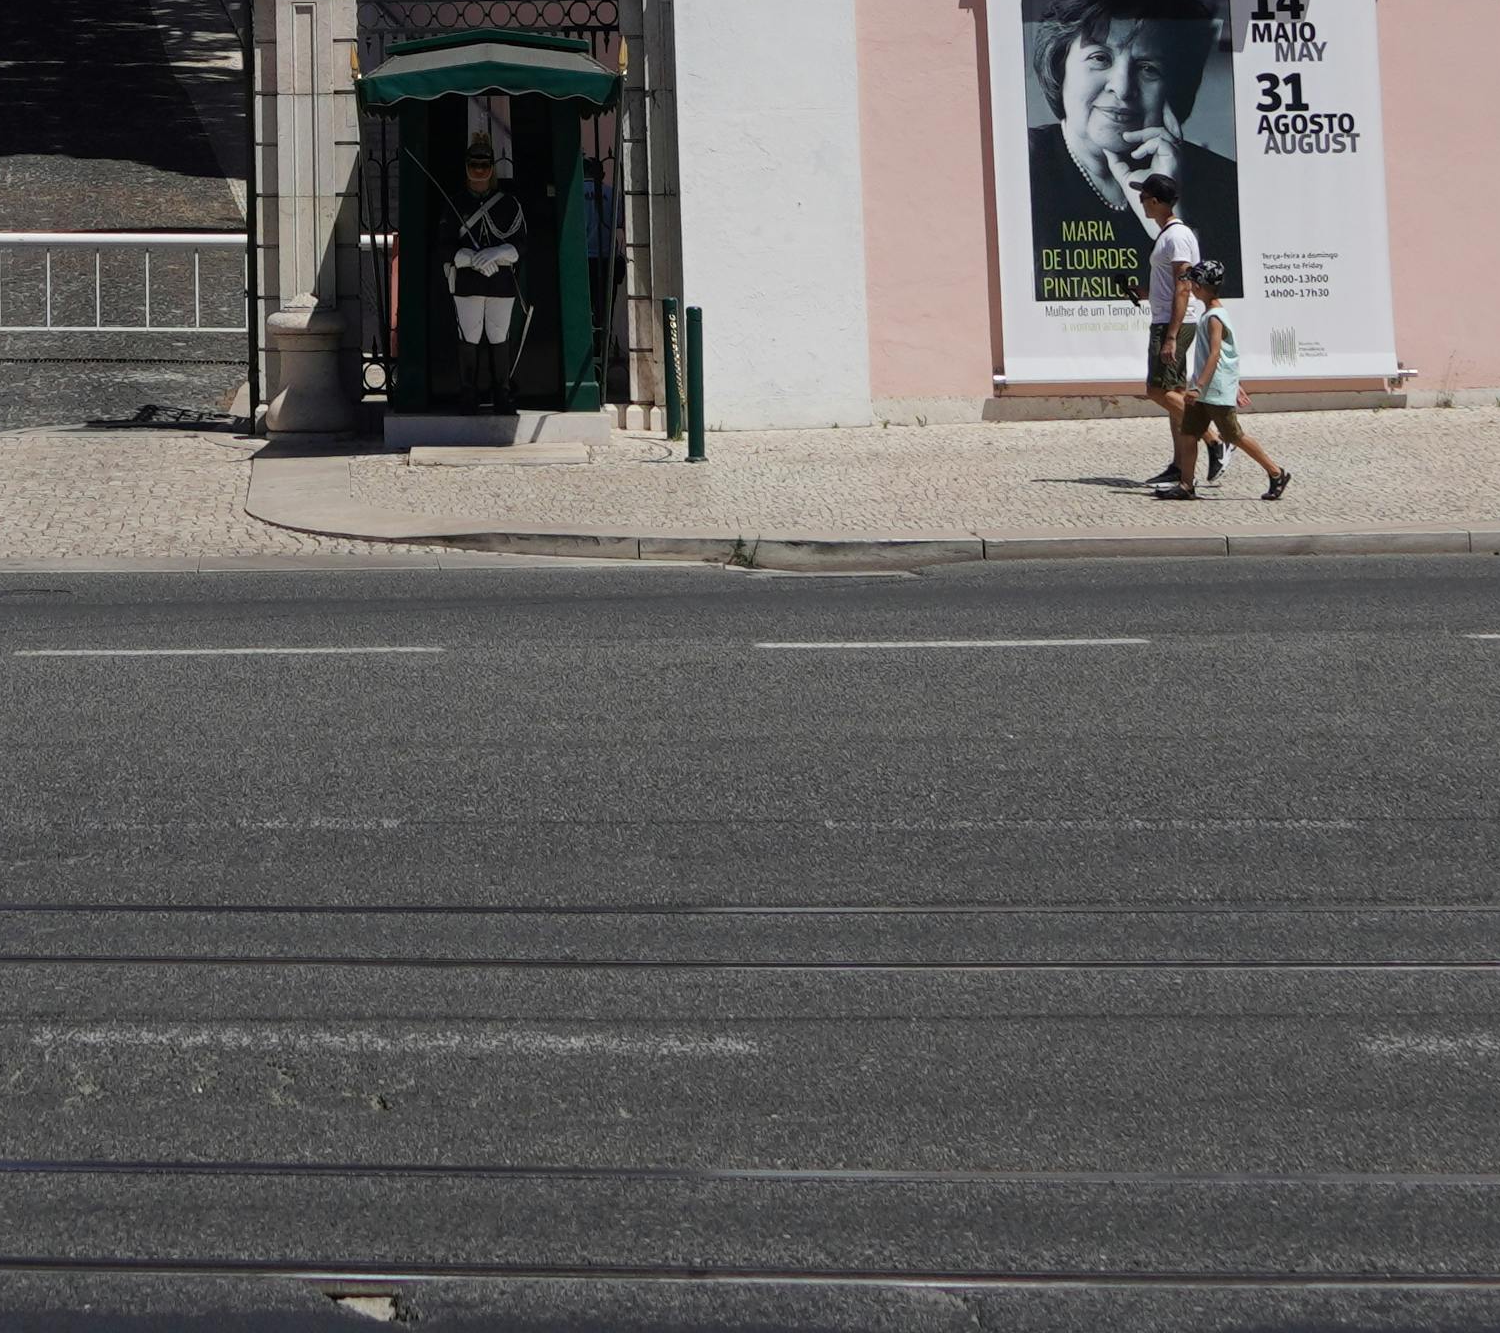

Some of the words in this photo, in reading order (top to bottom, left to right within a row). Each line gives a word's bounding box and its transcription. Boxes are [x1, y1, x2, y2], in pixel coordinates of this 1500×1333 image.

[1252, 22, 1316, 43] MAIO
[1275, 42, 1327, 62] MAY
[1256, 73, 1309, 112] 31
[1257, 113, 1355, 135] AGOSTO
[1264, 133, 1360, 154] AUGUST
[1062, 221, 1115, 241] MARIA
[1042, 249, 1062, 270] DE
[1066, 248, 1138, 269] LOURDES
[1264, 274, 1329, 284] 10h00-13h00
[1265, 289, 1330, 298] 14h00-17h30
[1045, 305, 1075, 317] Mulher
[1078, 305, 1089, 317] de
[1091, 307, 1105, 317] um
[1107, 304, 1136, 318] Tempo
